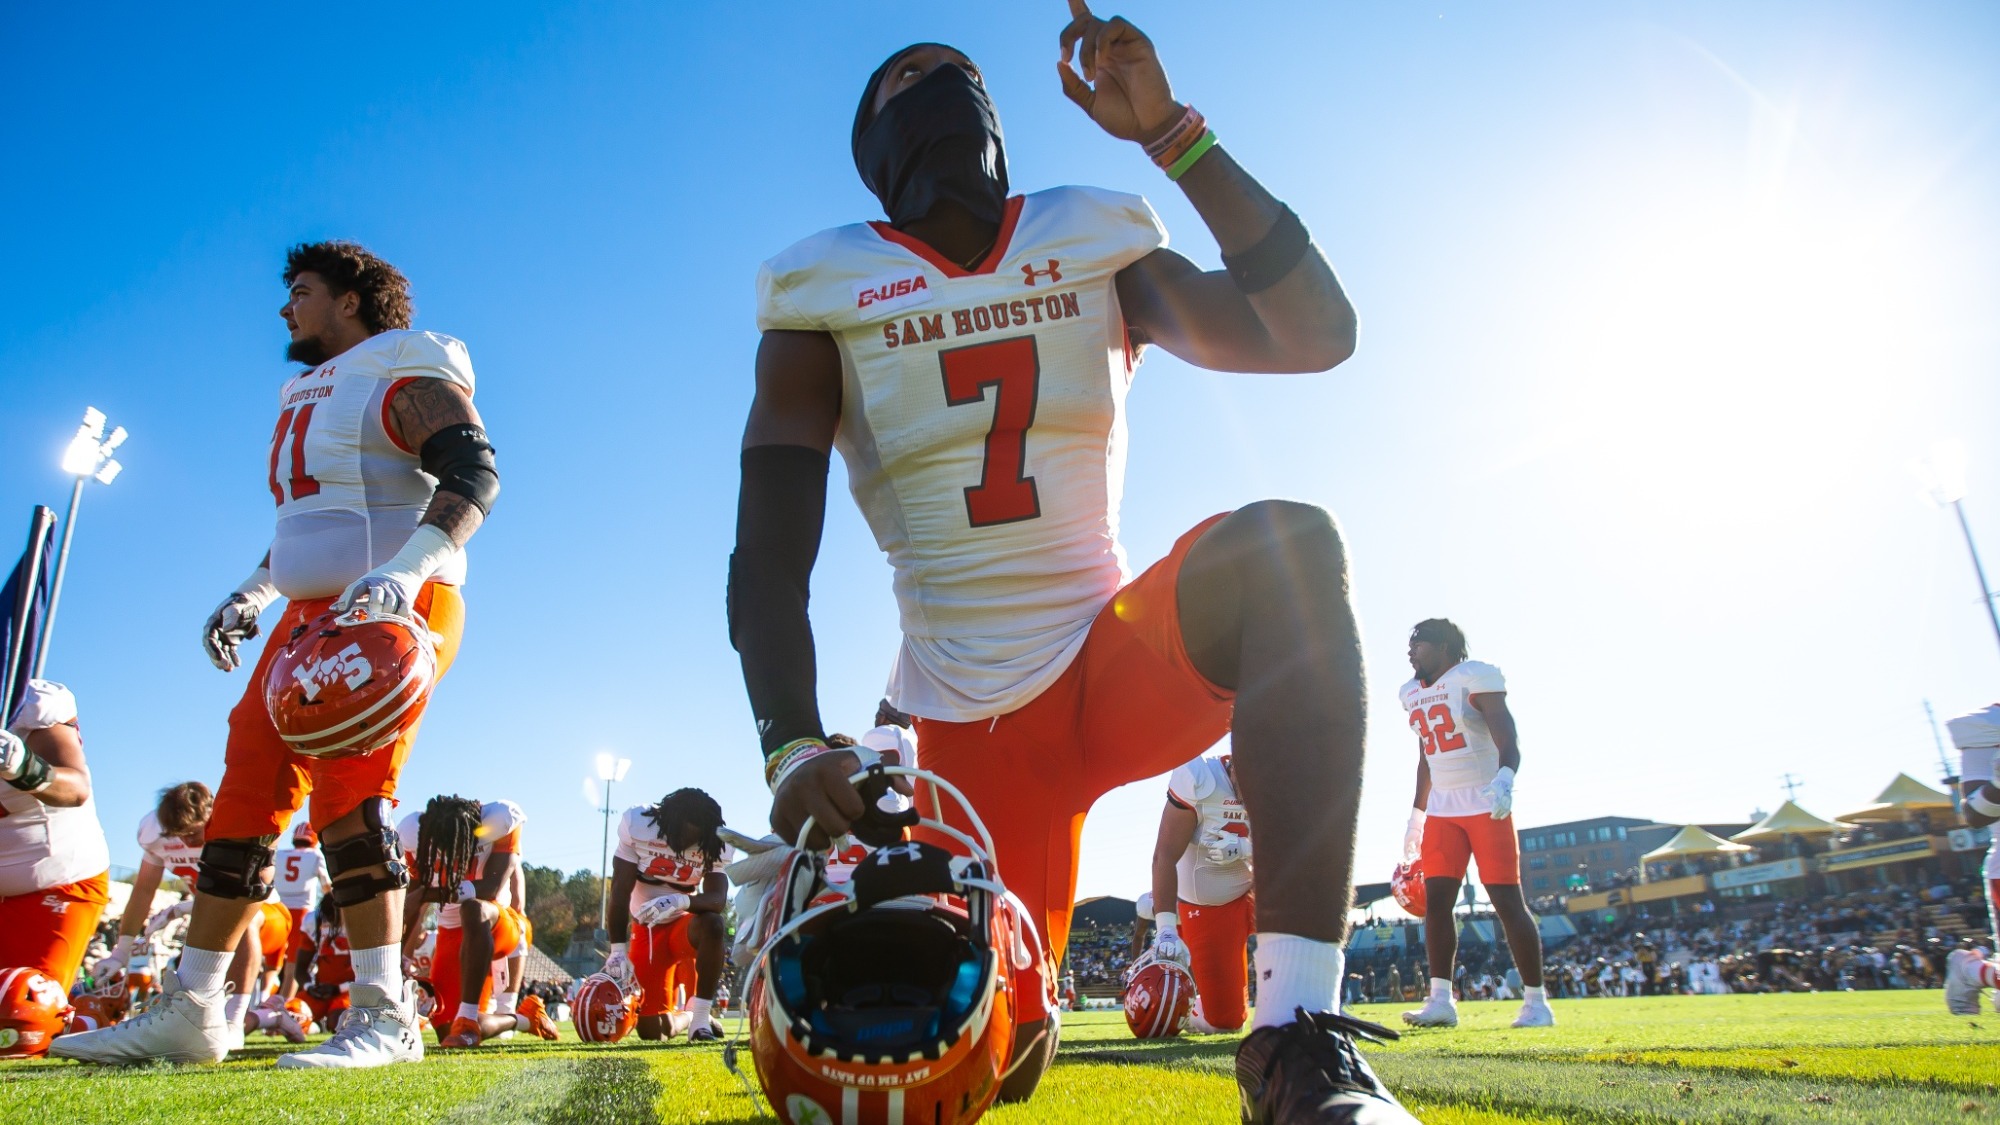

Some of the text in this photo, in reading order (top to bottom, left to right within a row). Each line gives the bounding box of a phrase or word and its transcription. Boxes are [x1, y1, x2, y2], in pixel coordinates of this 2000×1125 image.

[883, 291, 1081, 349] SAM HOUSTON
[287, 385, 334, 404] HOUSTON
[937, 333, 1042, 529] 7
[268, 402, 321, 508] 71
[1408, 702, 1468, 756] 32
[1222, 811, 1243, 820] SAM
[284, 855, 303, 883] 5
[857, 1075, 876, 1087] UP
